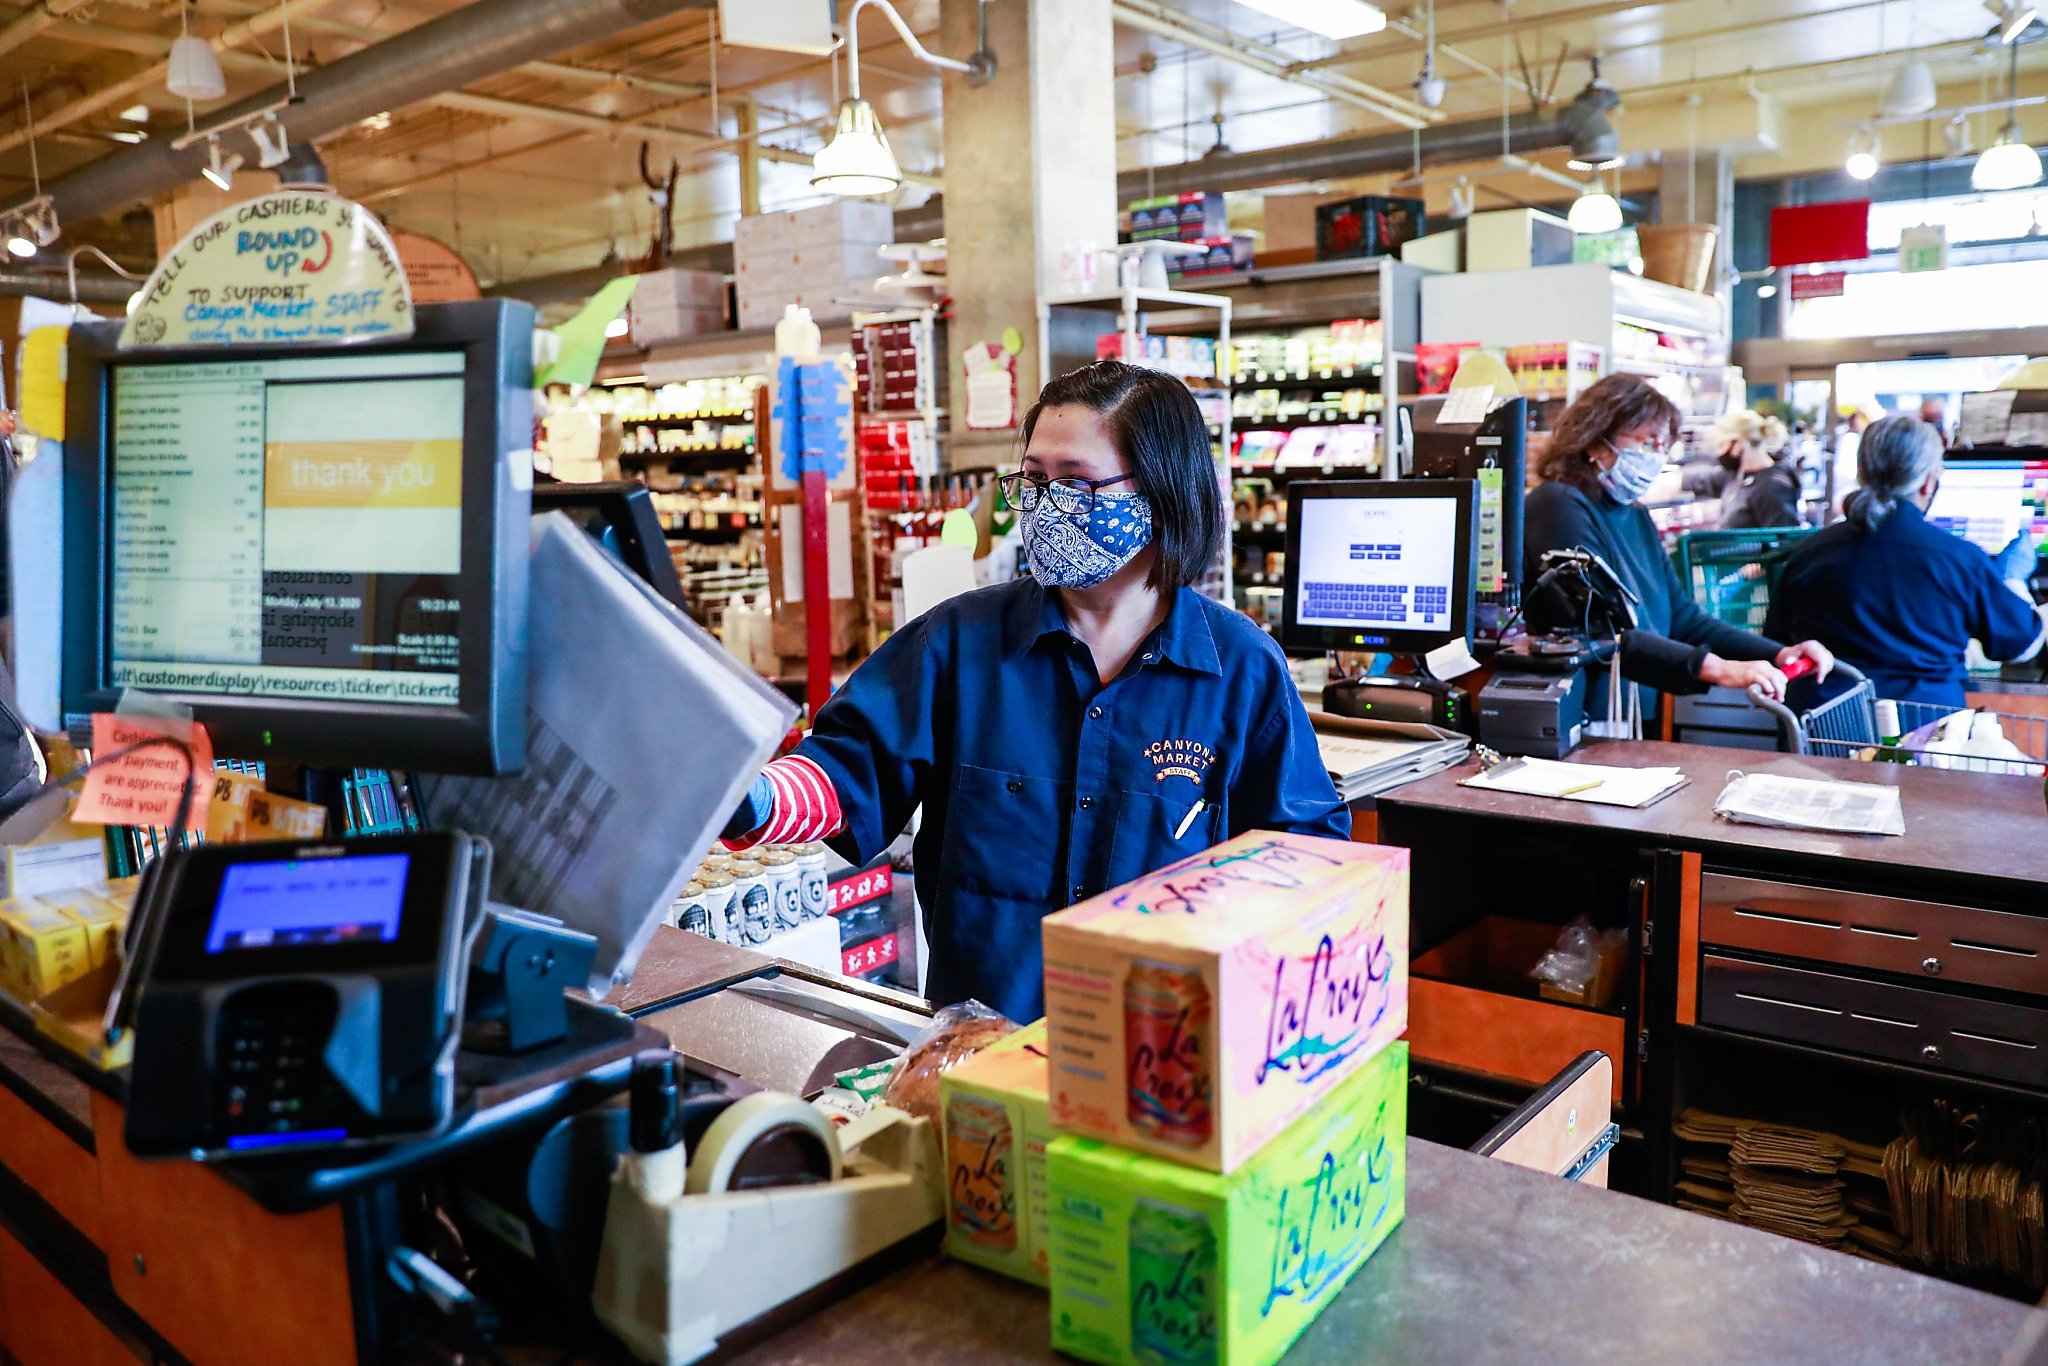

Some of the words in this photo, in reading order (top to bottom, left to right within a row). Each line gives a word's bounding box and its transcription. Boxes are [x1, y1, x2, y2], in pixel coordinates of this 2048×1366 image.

[237, 226, 318, 254] ROUND
[145, 255, 187, 306] TELL
[194, 221, 231, 252] OUR
[237, 198, 329, 224] CASHIERS
[266, 252, 299, 276] UP
[188, 288, 210, 303] TO
[221, 284, 309, 305] SUPPORT
[184, 302, 246, 329] Canyon
[252, 297, 316, 321] Market
[291, 459, 373, 488] thank
[380, 464, 435, 496] you
[1151, 739, 1210, 758] CANYON
[1152, 753, 1209, 770] MARKET
[1168, 767, 1192, 777] STAFF
[105, 774, 125, 785] are
[100, 793, 134, 808] Thank
[139, 801, 167, 813] you!
